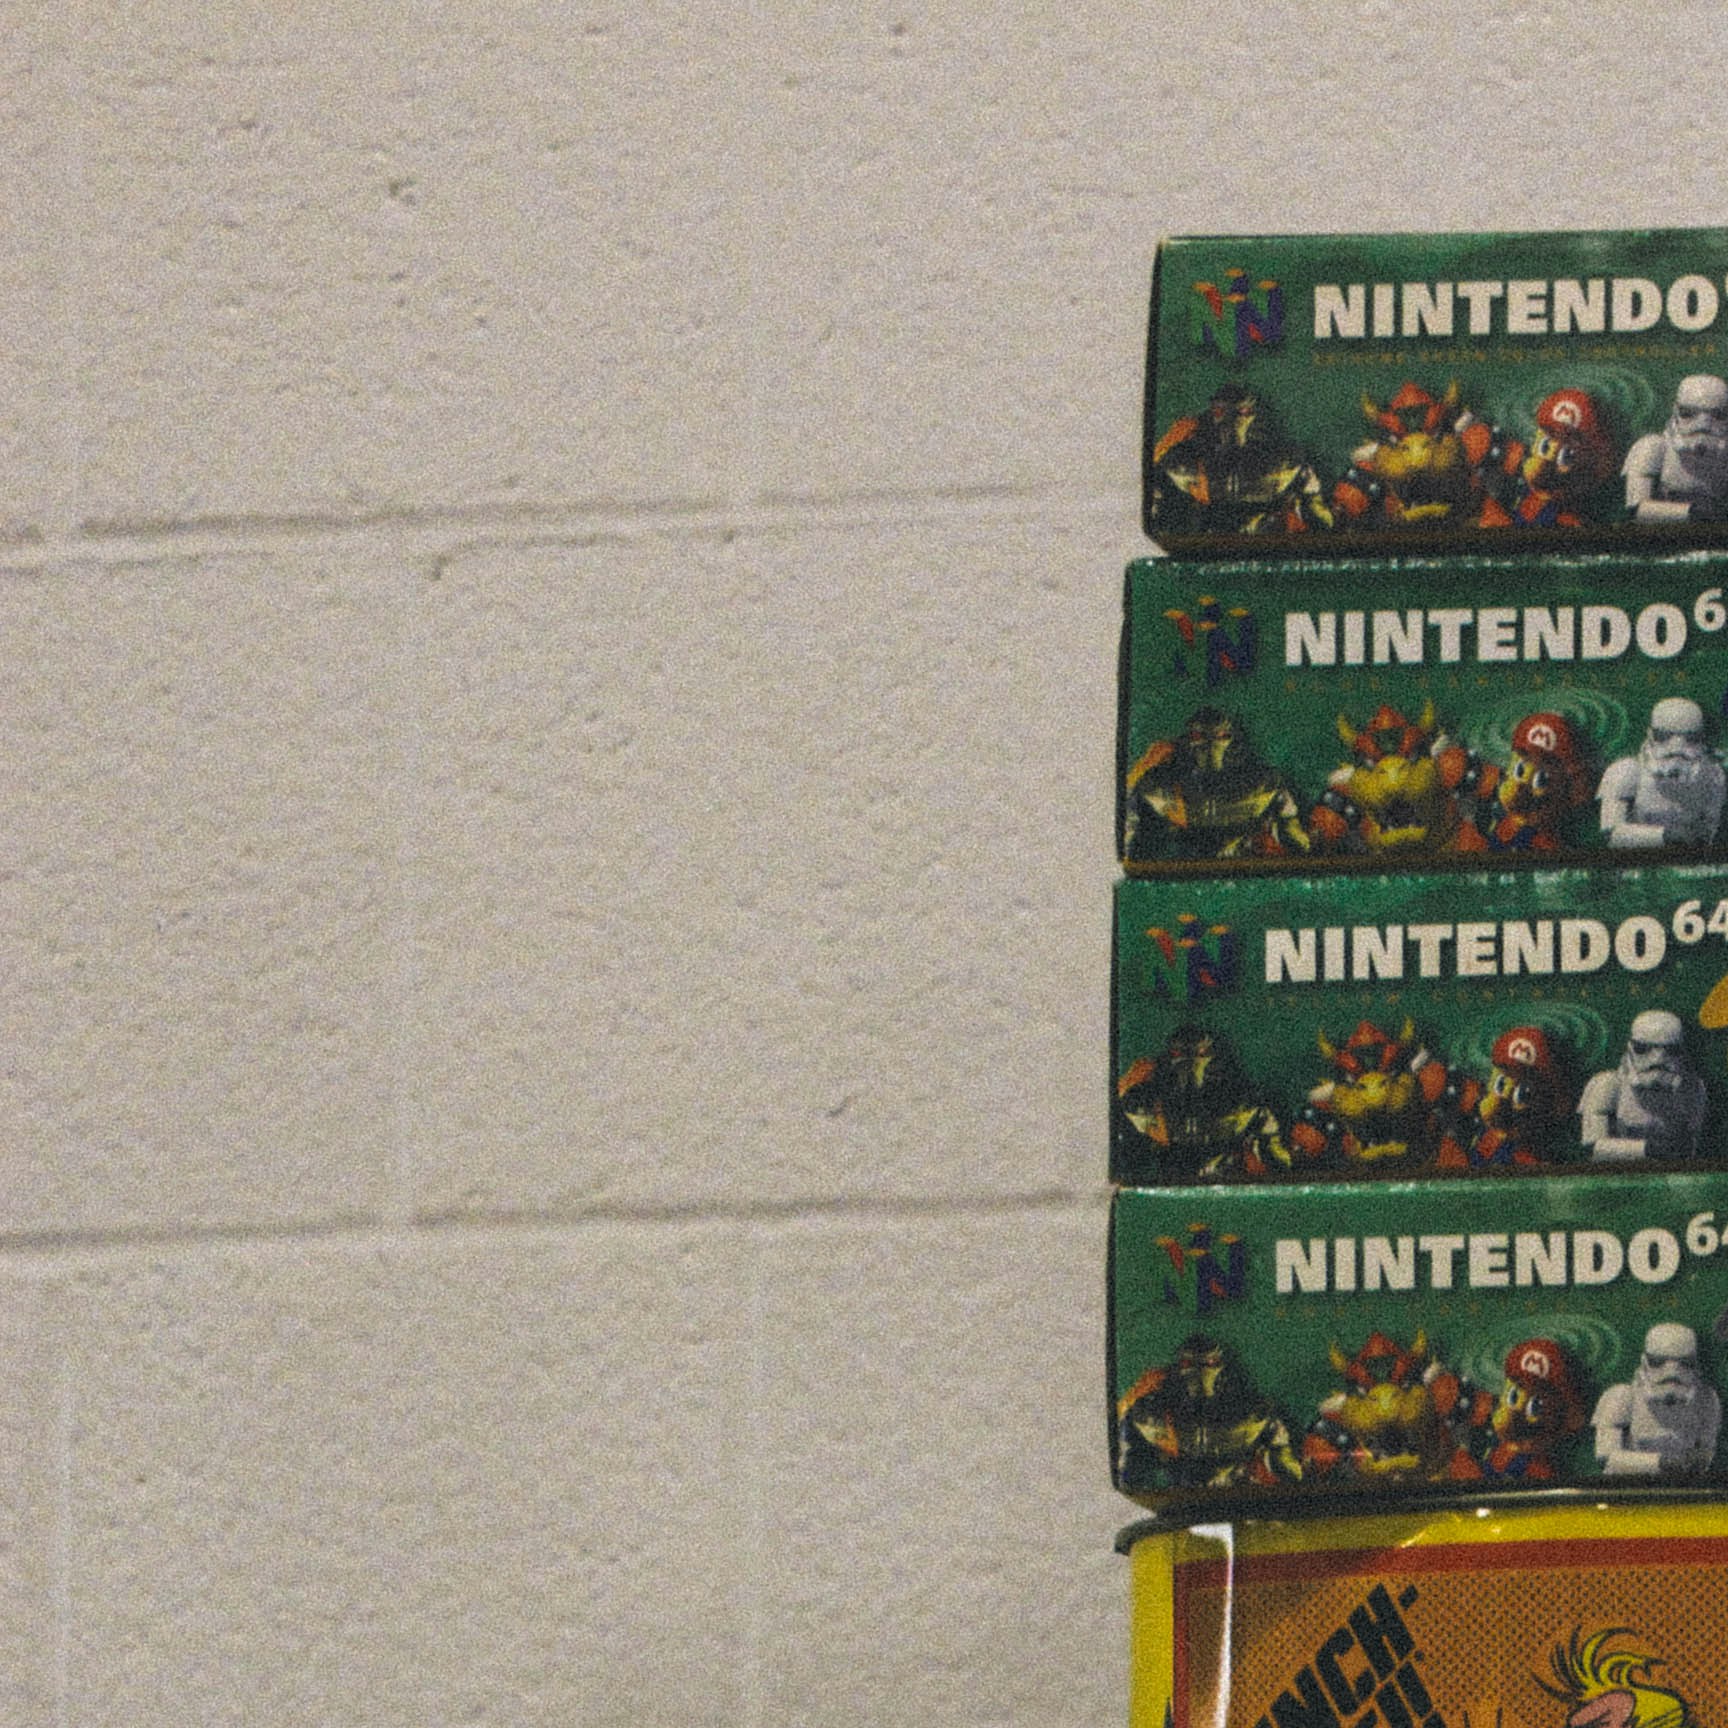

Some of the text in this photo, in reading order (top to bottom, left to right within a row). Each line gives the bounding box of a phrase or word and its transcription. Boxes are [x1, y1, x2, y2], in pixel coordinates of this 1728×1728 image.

[1313, 273, 1719, 338] NINTENDO
[1284, 602, 1688, 666] NINTENDO
[1264, 915, 1667, 983] NINTENDO
[1275, 1228, 1681, 1293] NINTENDO
